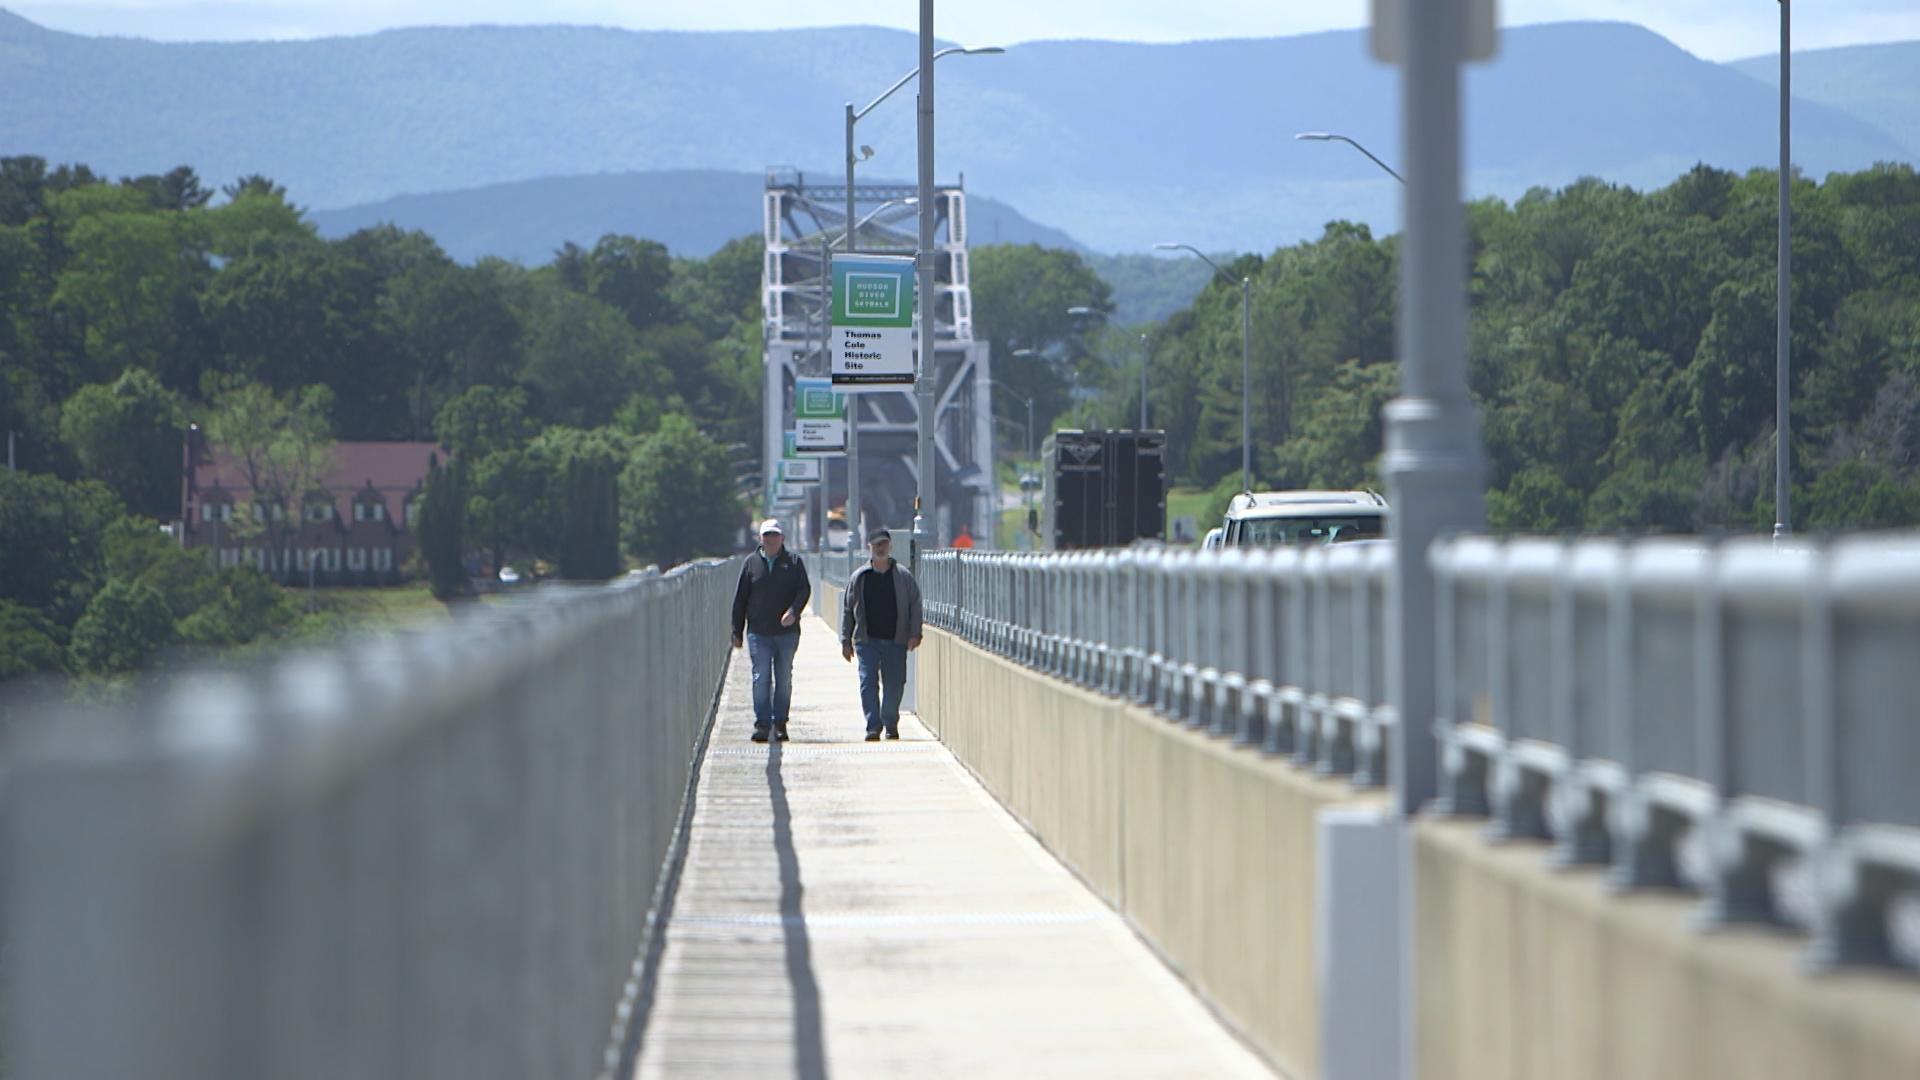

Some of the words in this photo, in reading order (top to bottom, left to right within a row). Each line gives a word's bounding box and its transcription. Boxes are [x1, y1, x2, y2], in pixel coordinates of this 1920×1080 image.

[844, 341, 865, 349] Cole
[844, 351, 882, 360] Historic
[844, 362, 864, 370] Site
